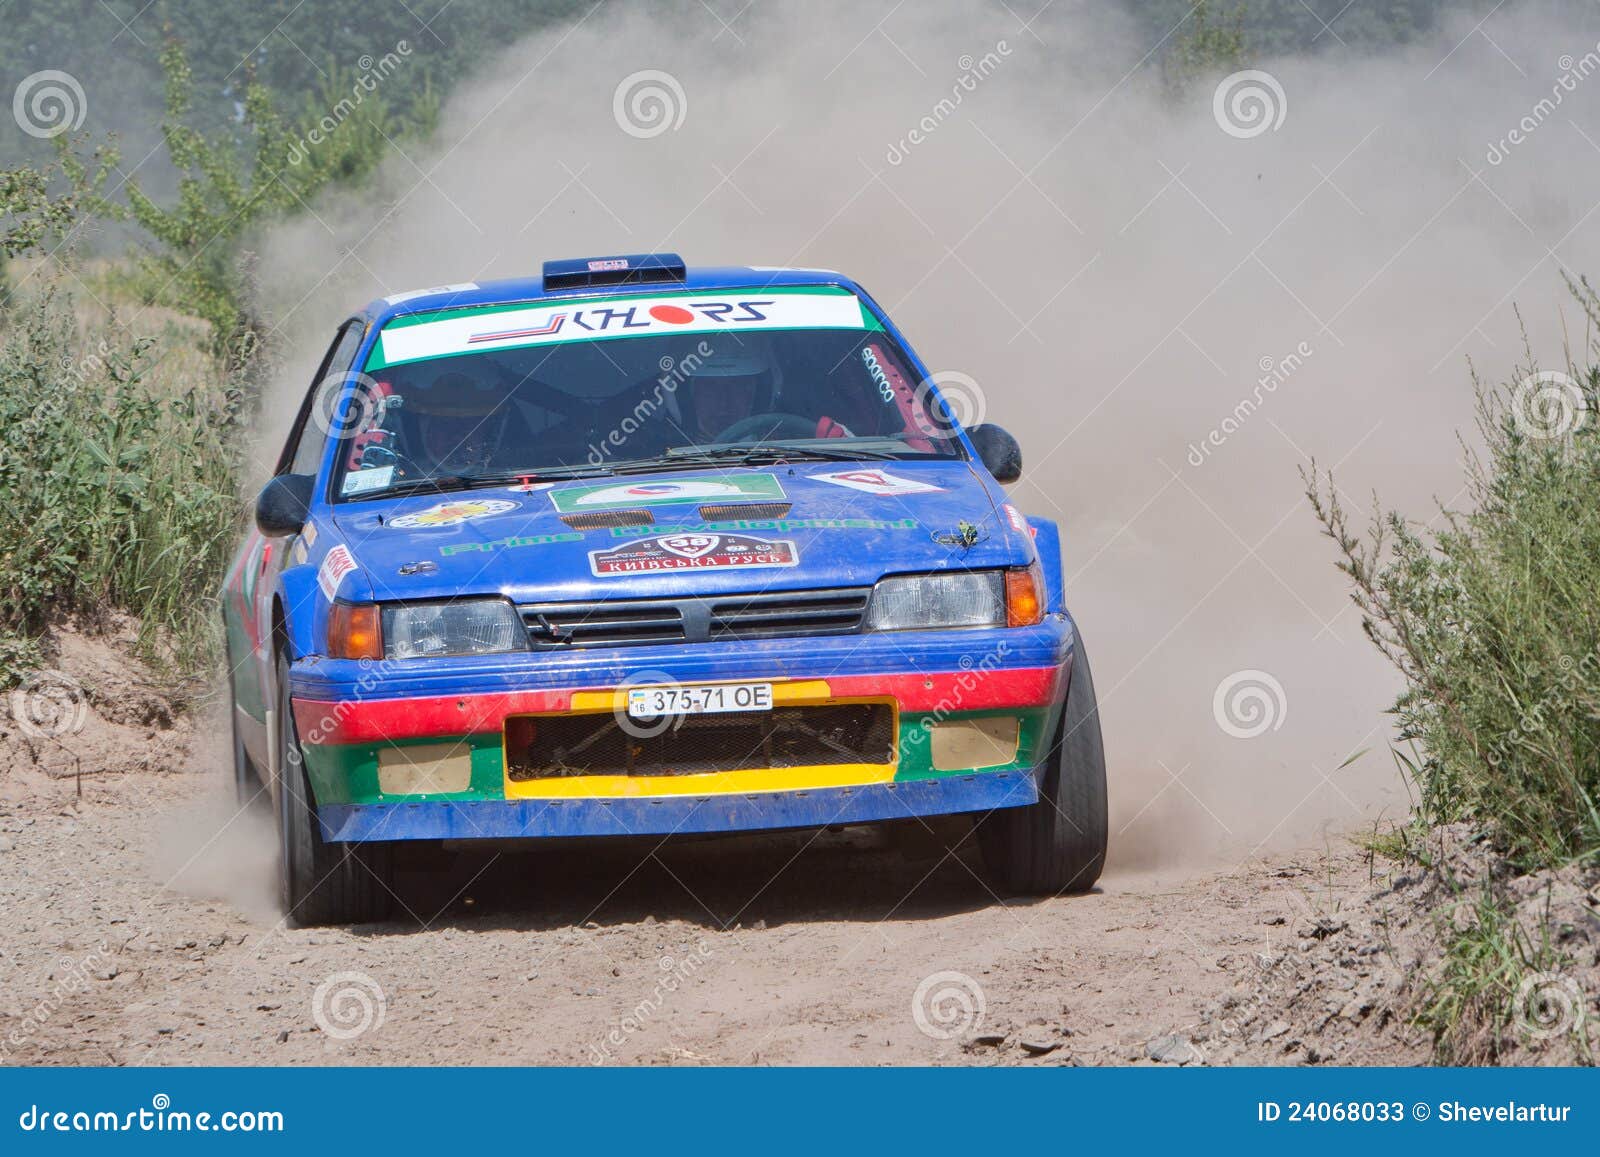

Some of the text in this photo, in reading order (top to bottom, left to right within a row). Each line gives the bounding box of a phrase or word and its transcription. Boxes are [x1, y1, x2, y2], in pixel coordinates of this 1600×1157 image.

[439, 532, 585, 557] Prime
[610, 518, 919, 538] Development
[729, 554, 781, 565] РУСЬ
[635, 686, 768, 713] 16 375-71 OE
